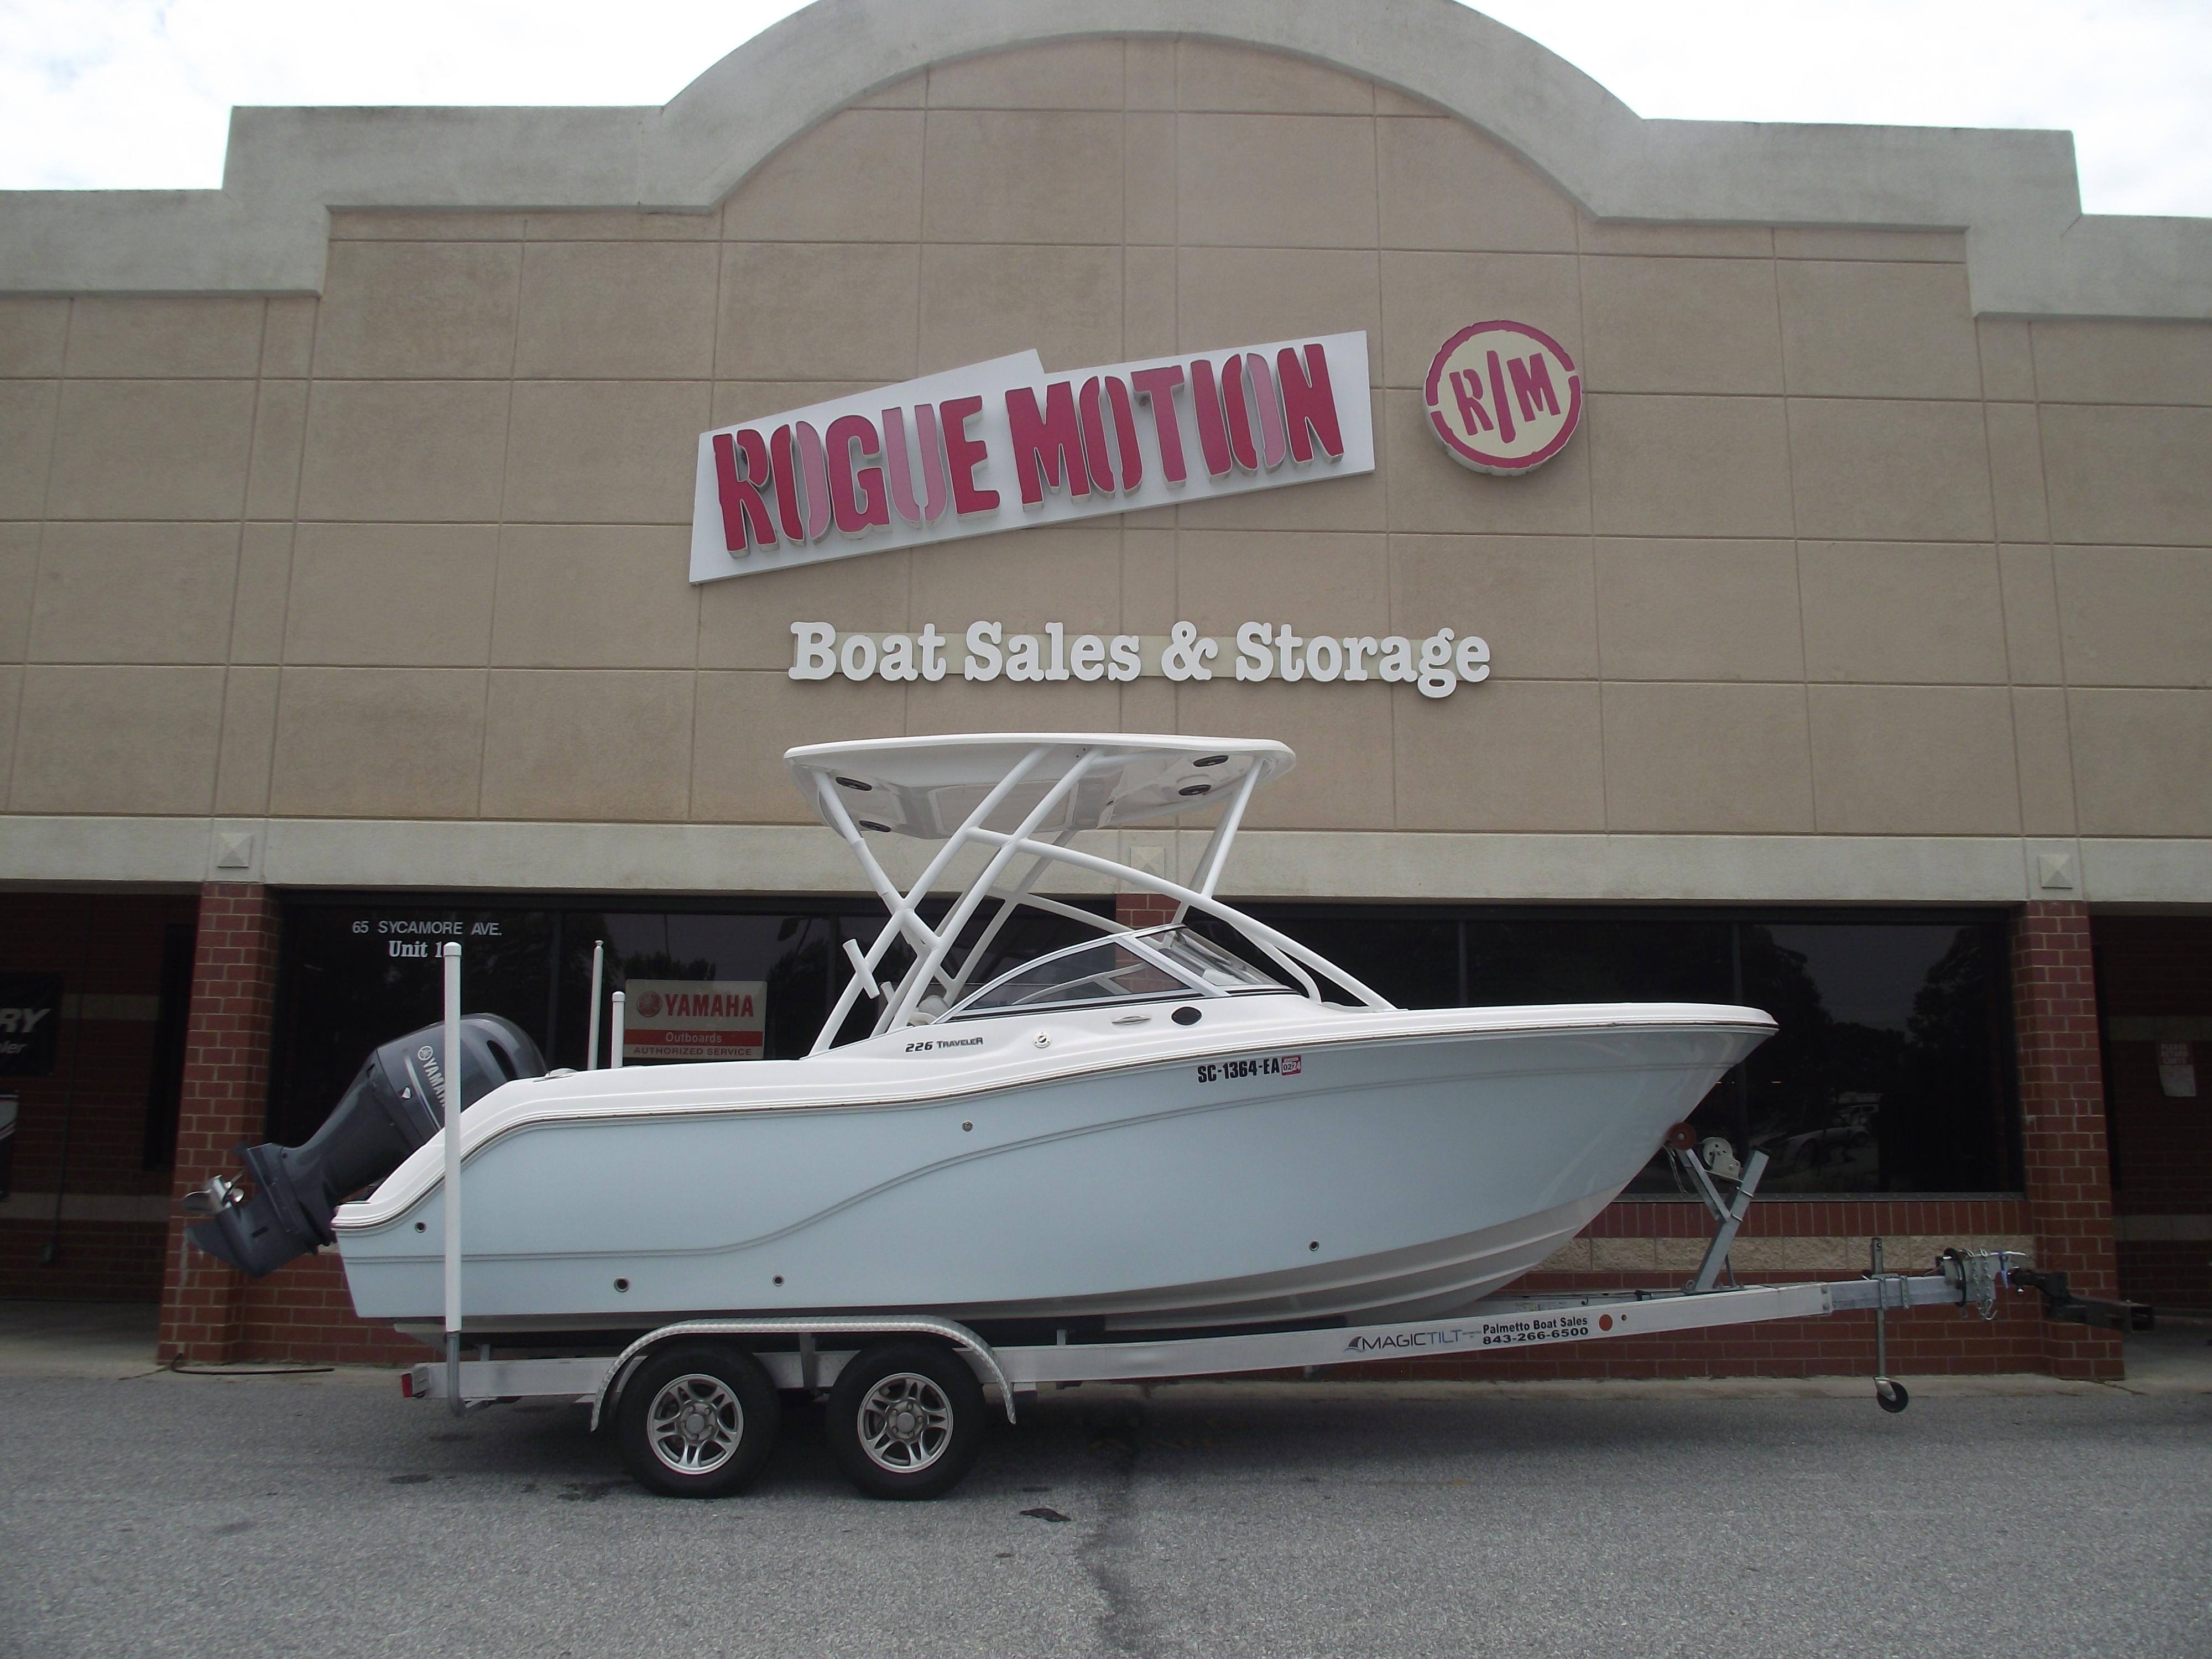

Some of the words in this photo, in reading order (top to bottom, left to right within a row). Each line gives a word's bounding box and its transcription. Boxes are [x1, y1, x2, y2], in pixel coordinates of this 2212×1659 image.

[712, 394, 1001, 557] ROGUE
[1004, 342, 1345, 511] MOTION
[788, 621, 946, 681] Boat
[964, 620, 1142, 681] Sales
[1161, 620, 1218, 681] &
[1235, 621, 1490, 698] Storage
[352, 920, 369, 933] 65
[378, 920, 463, 935] SYCAMORE
[471, 922, 503, 936] AVE.
[389, 940, 428, 958] Unit
[665, 993, 754, 1018] YAMAHA
[665, 1031, 722, 1044] Outboards
[905, 1041, 933, 1052] 226
[936, 1037, 983, 1049] TRAVELER
[634, 1046, 703, 1056] AUTHORIZED
[706, 1047, 752, 1056] SERVICE
[1197, 1058, 1280, 1083] SC-1364-EA
[1483, 1322, 1530, 1334] Palmetto
[1533, 1318, 1557, 1330] Boat
[1560, 1316, 1588, 1327] Sales
[1482, 1327, 1589, 1345] 843-266-6500
